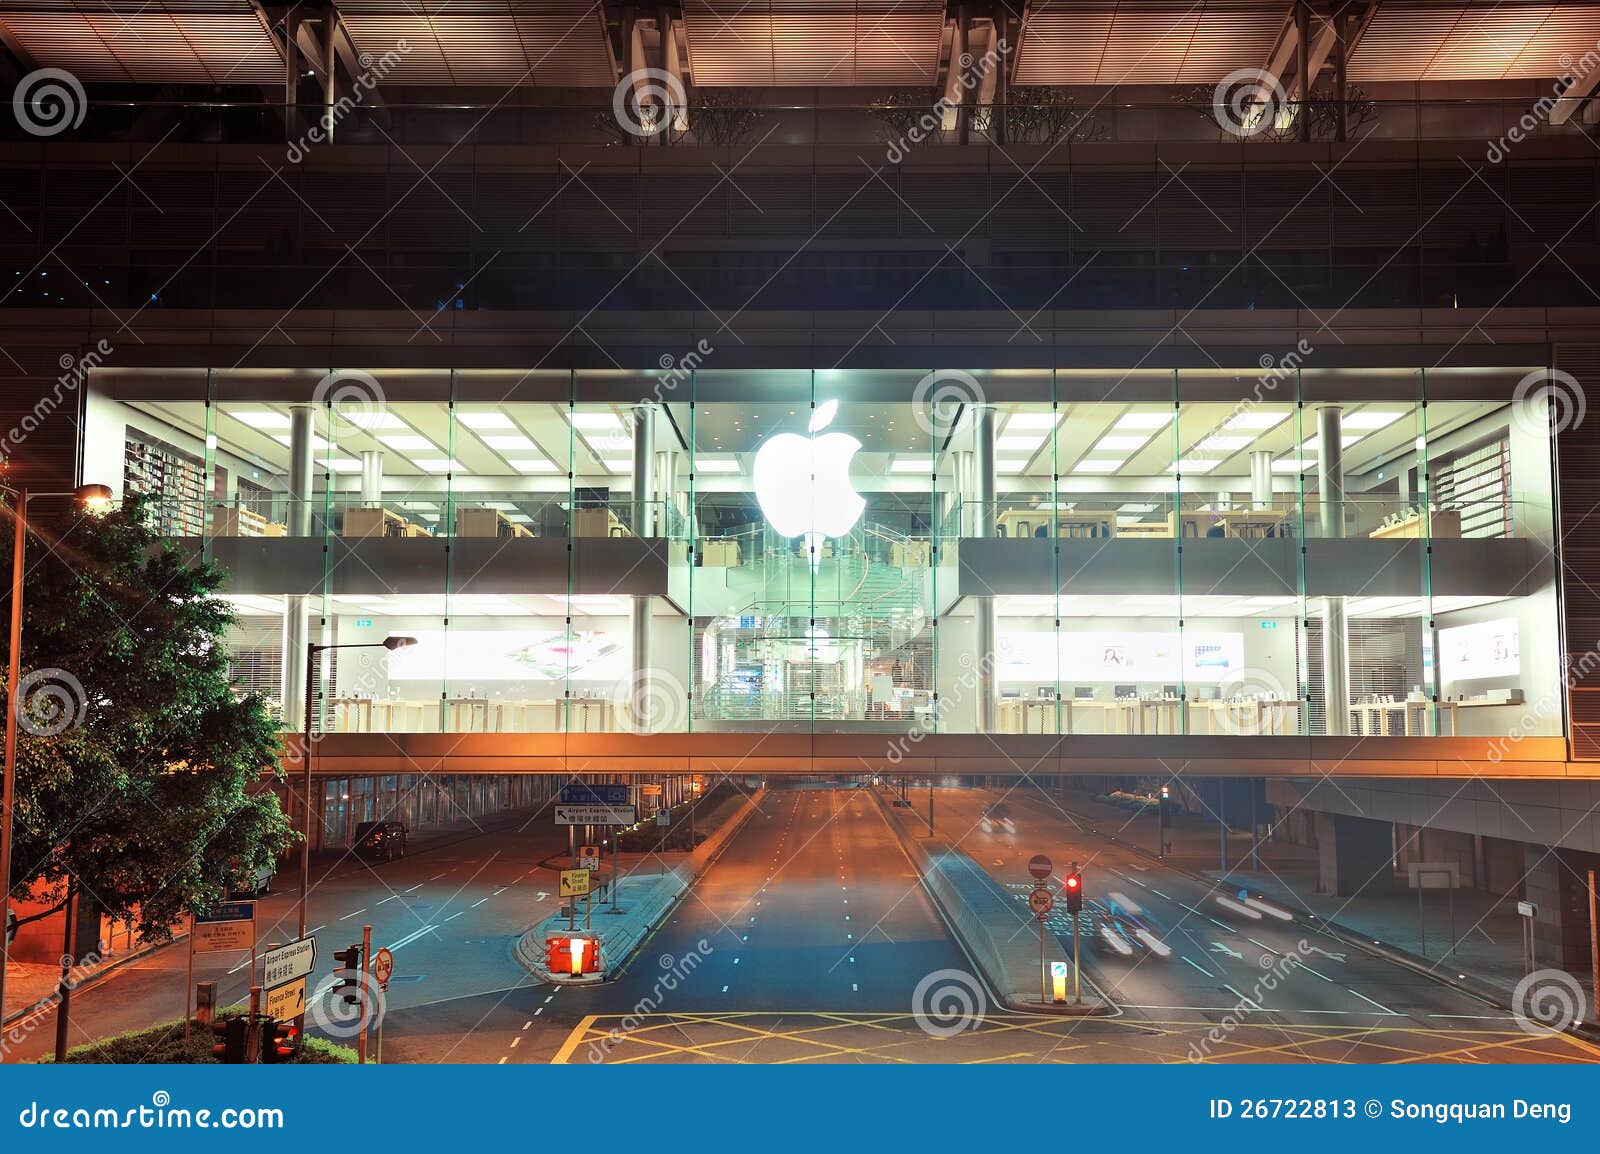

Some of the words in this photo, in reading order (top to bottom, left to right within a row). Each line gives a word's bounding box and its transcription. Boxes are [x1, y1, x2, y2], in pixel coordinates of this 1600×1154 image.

[568, 807, 587, 815] Airport
[589, 807, 611, 815] Express
[266, 954, 281, 965] Airport
[281, 949, 297, 960] Express
[297, 943, 310, 955] Station
[269, 994, 285, 1005] Finance
[284, 988, 296, 1000] Street
